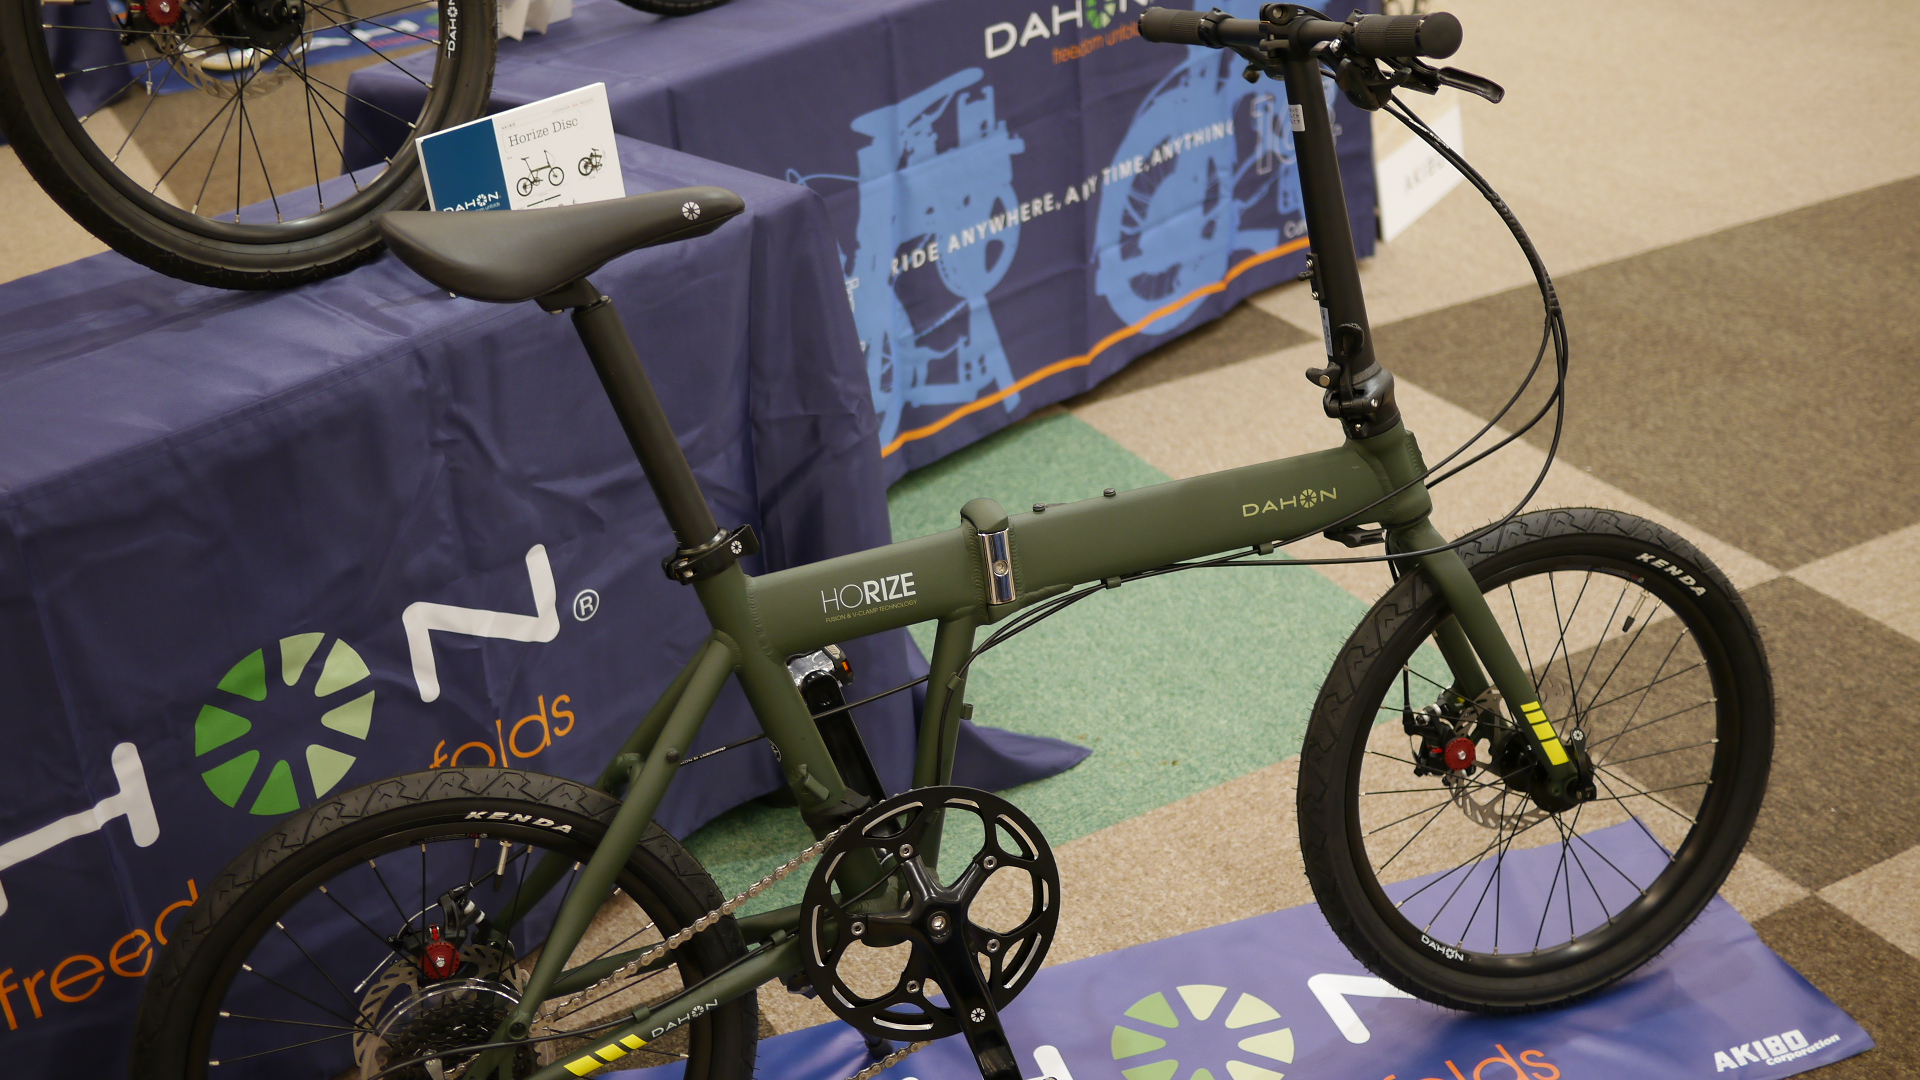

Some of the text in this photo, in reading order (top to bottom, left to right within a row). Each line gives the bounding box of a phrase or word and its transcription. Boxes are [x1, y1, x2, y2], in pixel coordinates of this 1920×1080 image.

[508, 116, 578, 148] Horize Disc
[891, 242, 940, 277] RIDE
[1242, 487, 1337, 517] DAHON
[1636, 553, 1707, 596] KENDA
[821, 572, 916, 614] HORIZE
[825, 614, 847, 623] FUSION
[852, 607, 879, 618] V-CLAMP
[879, 600, 918, 612] TECHNOLOGY
[464, 811, 573, 834] KENDA
[1421, 934, 1464, 961] DAHON
[651, 999, 718, 1038] DAHON
[1714, 1029, 1809, 1072] AKIBO
